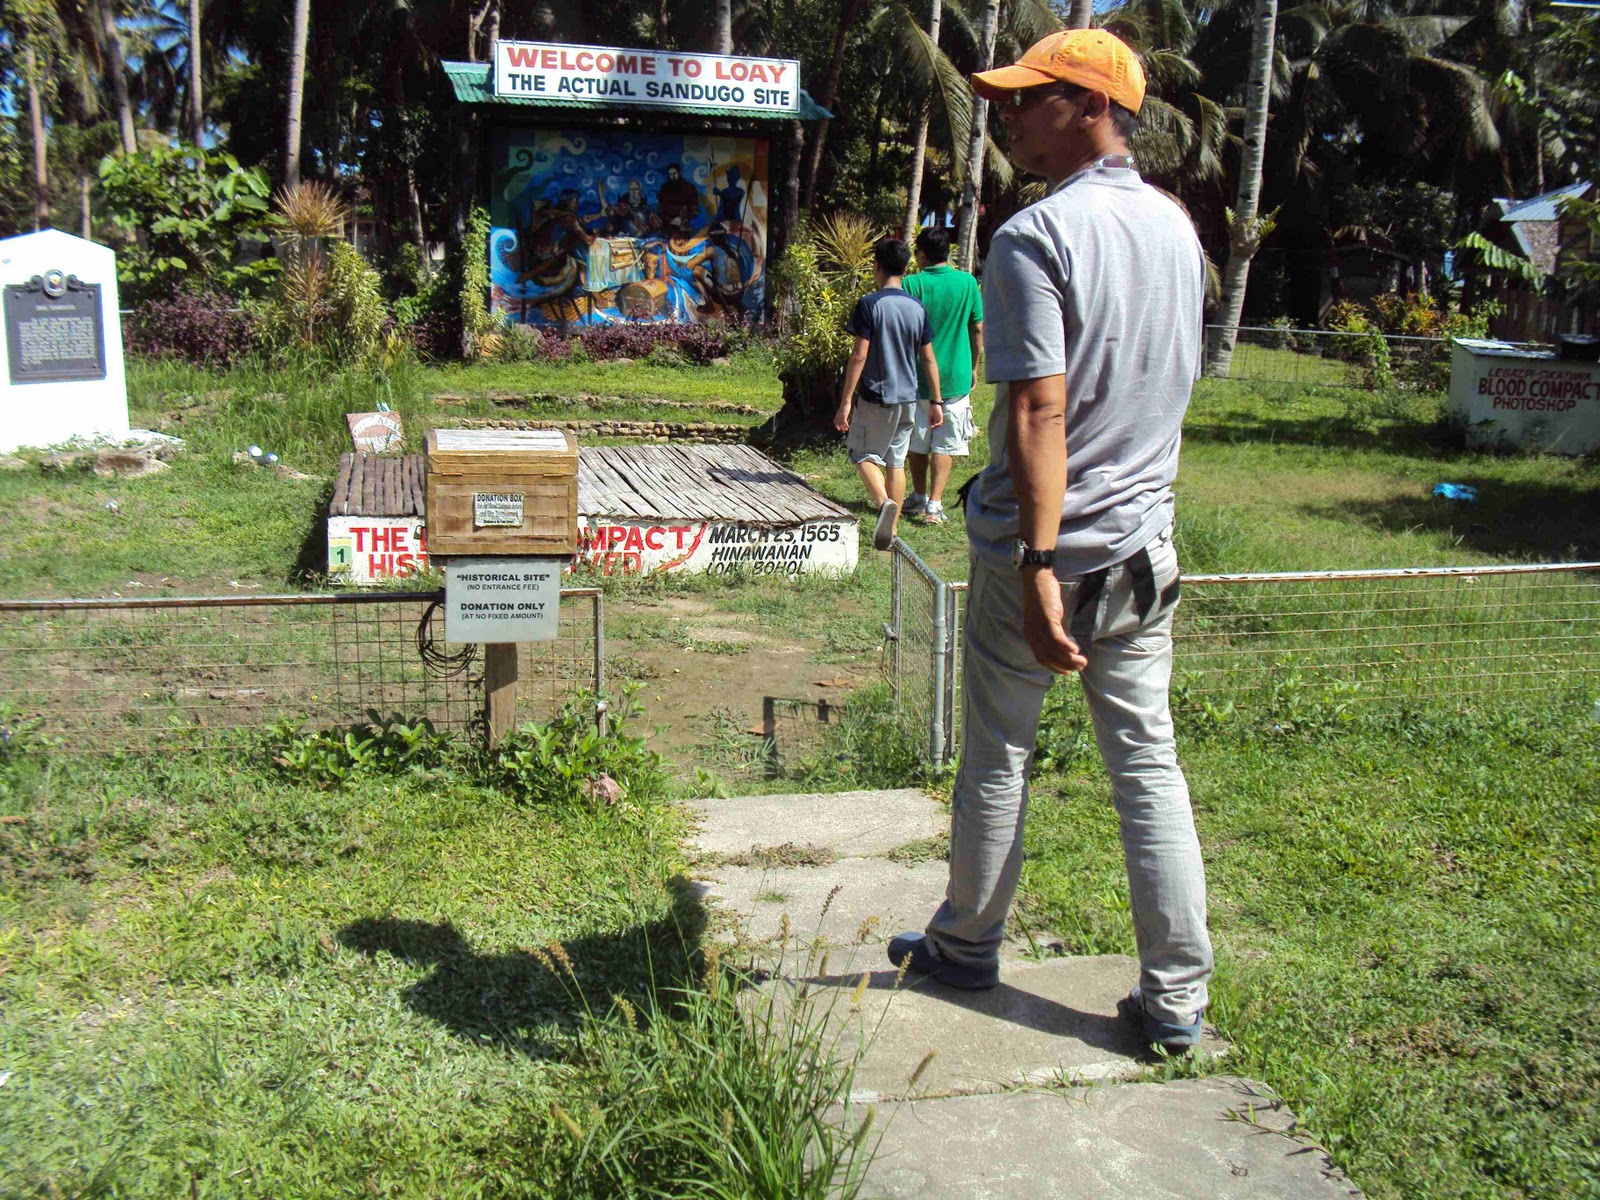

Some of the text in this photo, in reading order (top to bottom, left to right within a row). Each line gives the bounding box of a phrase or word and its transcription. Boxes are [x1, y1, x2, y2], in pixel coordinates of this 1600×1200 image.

[507, 47, 788, 84] WELCOME TO LOAY
[508, 73, 790, 106] THE ACTUAL SANDUGO SITE
[1478, 377, 1600, 400] BLOOD COMPACT
[1493, 396, 1577, 412] PHOTOSHOP
[476, 494, 523, 502] DONATION BOX
[349, 527, 408, 552] THE
[577, 525, 691, 550] MPACT
[708, 524, 769, 544] MARCH
[800, 524, 841, 543] 1565
[336, 548, 345, 563] 1
[711, 544, 813, 562] HINAWANAN
[753, 559, 806, 576] BOHOL
[523, 583, 539, 591] FEE)
[517, 602, 545, 610] ONLY
[510, 612, 544, 620] AMOUNT)
